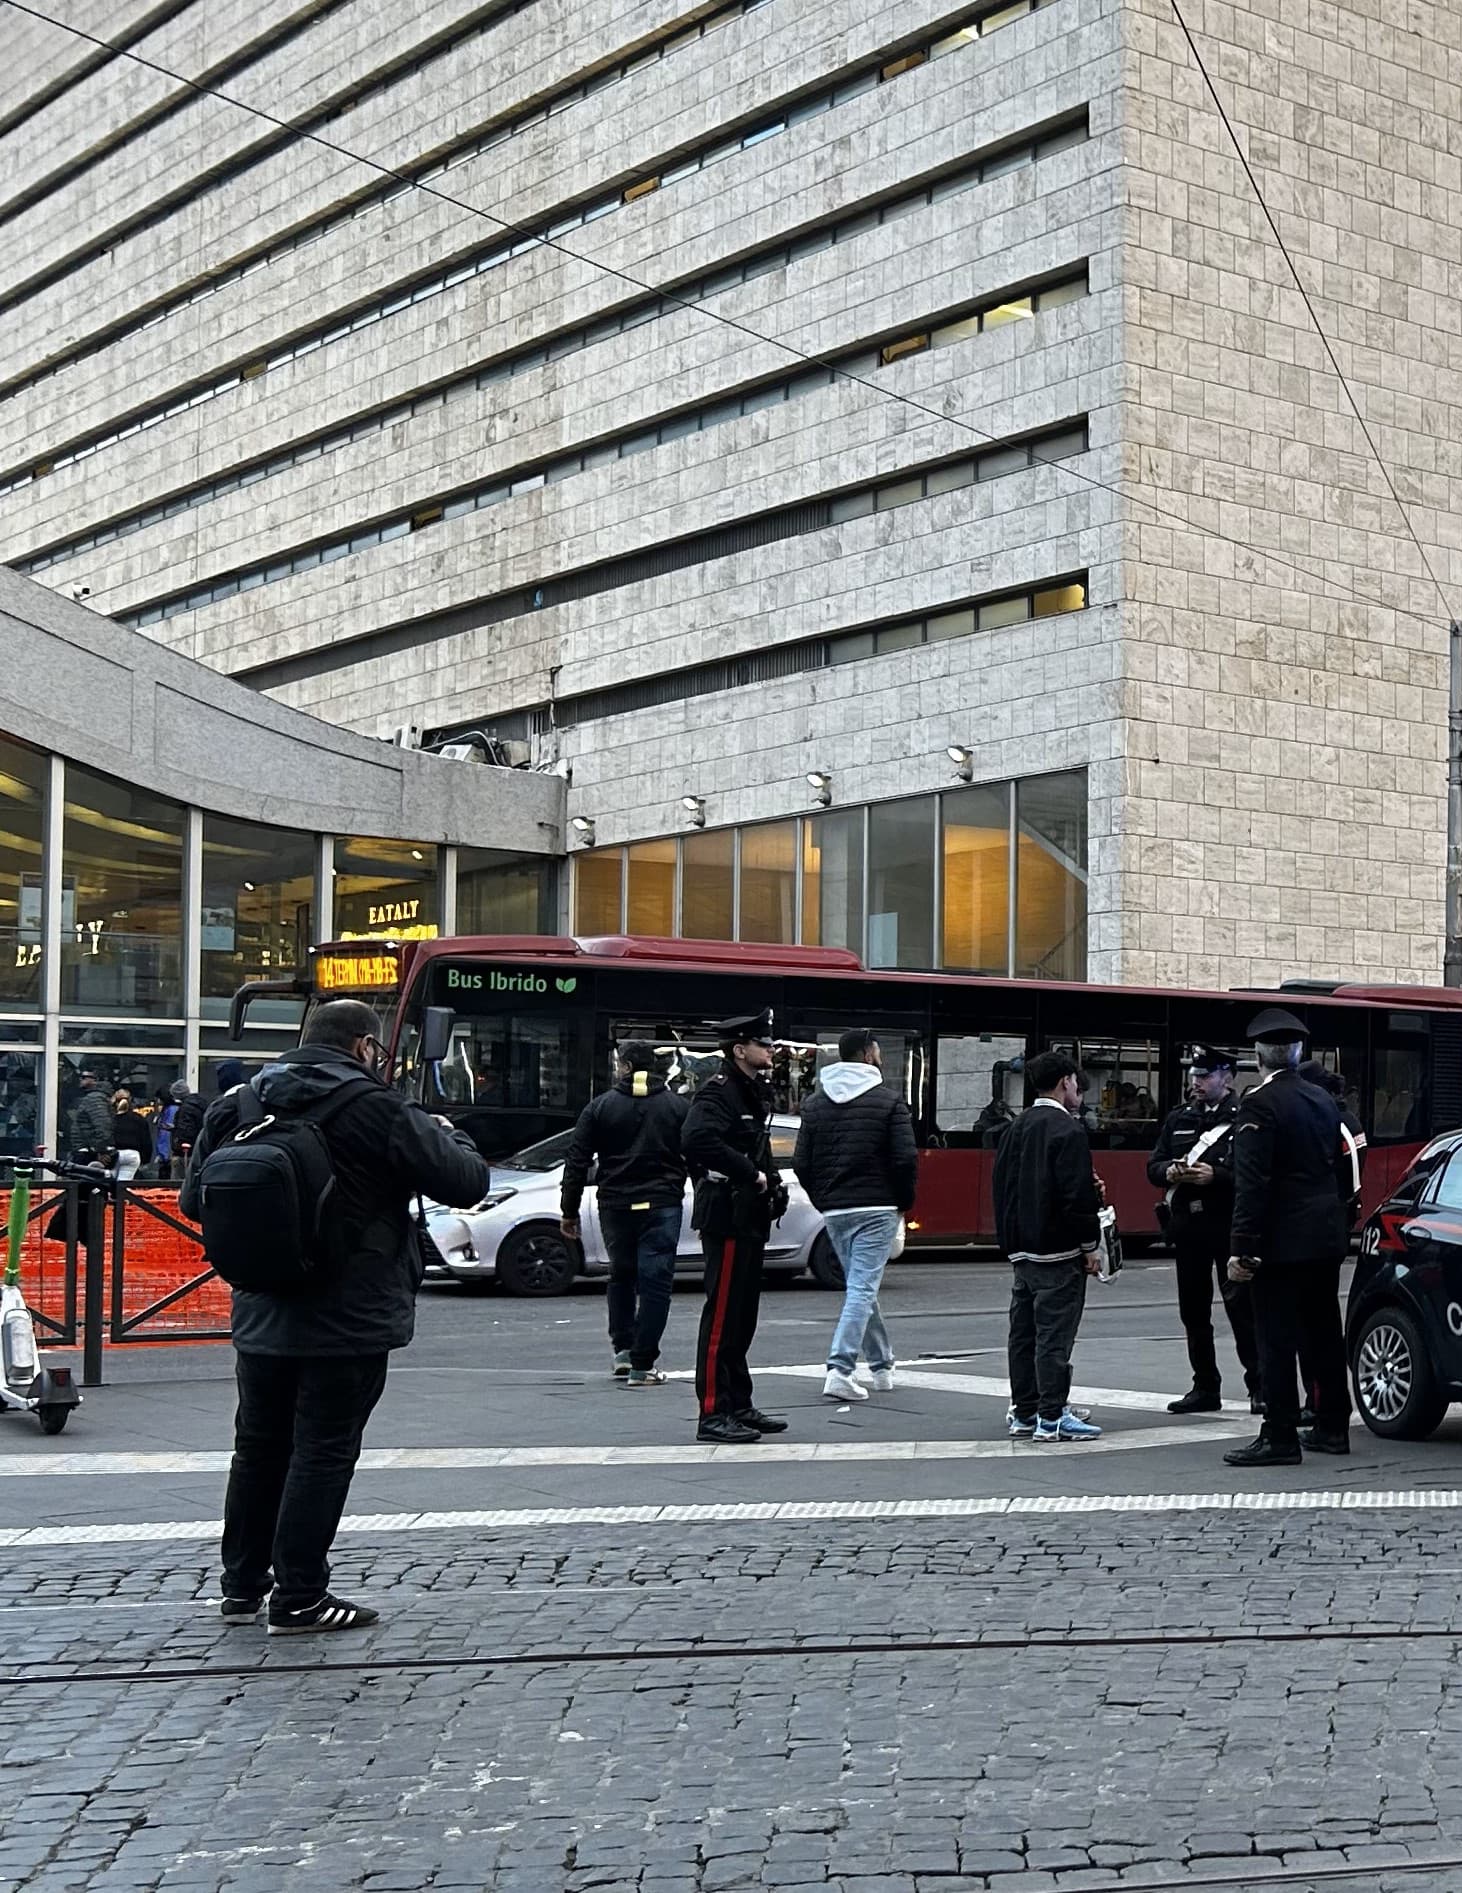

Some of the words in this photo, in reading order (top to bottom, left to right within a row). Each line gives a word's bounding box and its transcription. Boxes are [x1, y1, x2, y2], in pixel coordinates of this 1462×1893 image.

[369, 900, 420, 925] EATALY
[448, 968, 482, 989] Bus
[490, 971, 548, 992] Ibrido
